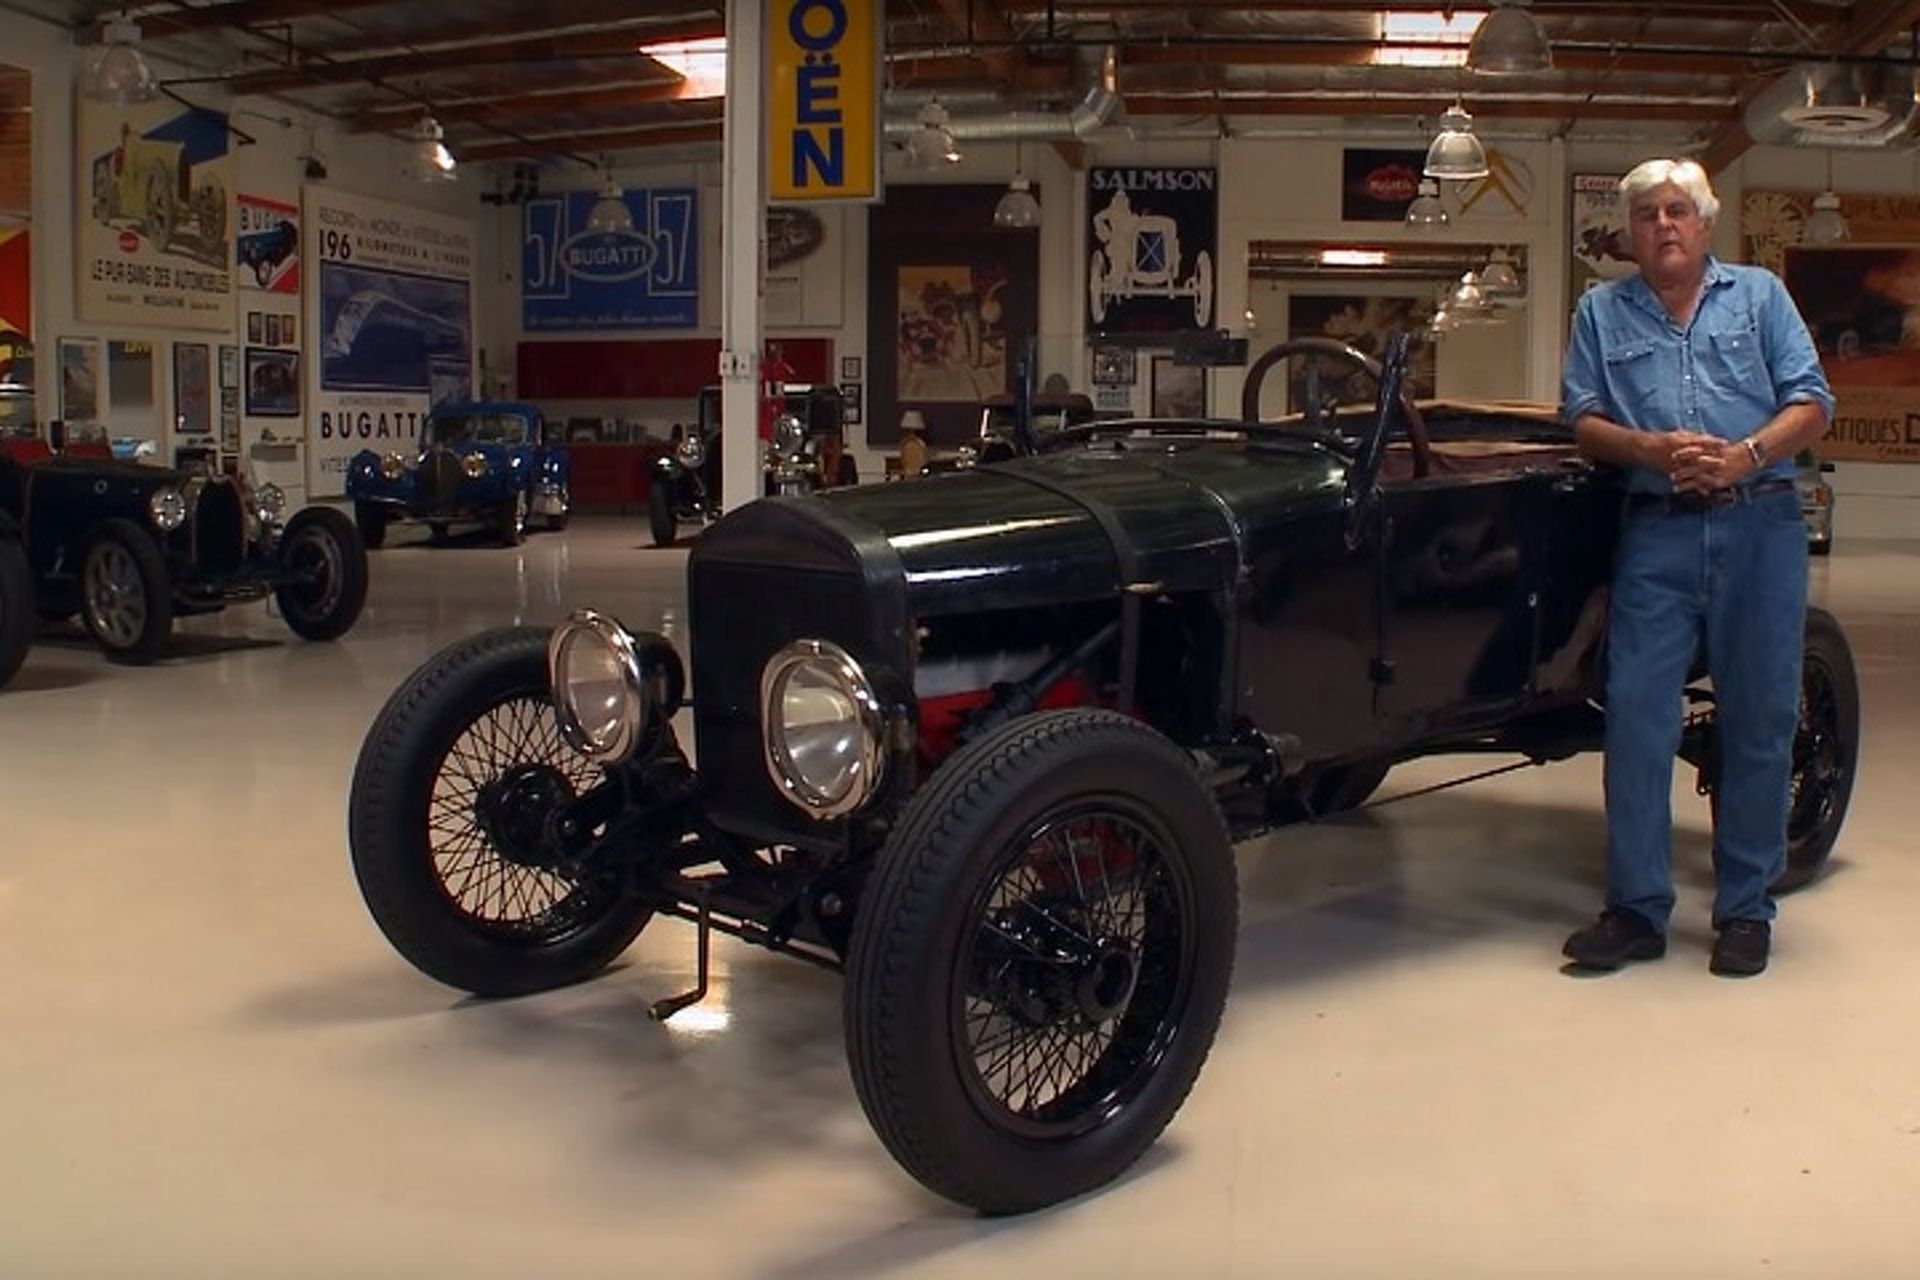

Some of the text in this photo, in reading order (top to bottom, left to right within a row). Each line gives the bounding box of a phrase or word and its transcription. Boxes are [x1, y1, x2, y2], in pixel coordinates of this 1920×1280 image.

[1092, 170, 1214, 191] SALMSON
[320, 219, 351, 260] 196
[653, 195, 692, 284] 57
[569, 246, 647, 266] BUGATTI
[1822, 417, 1899, 445] ATIQUES
